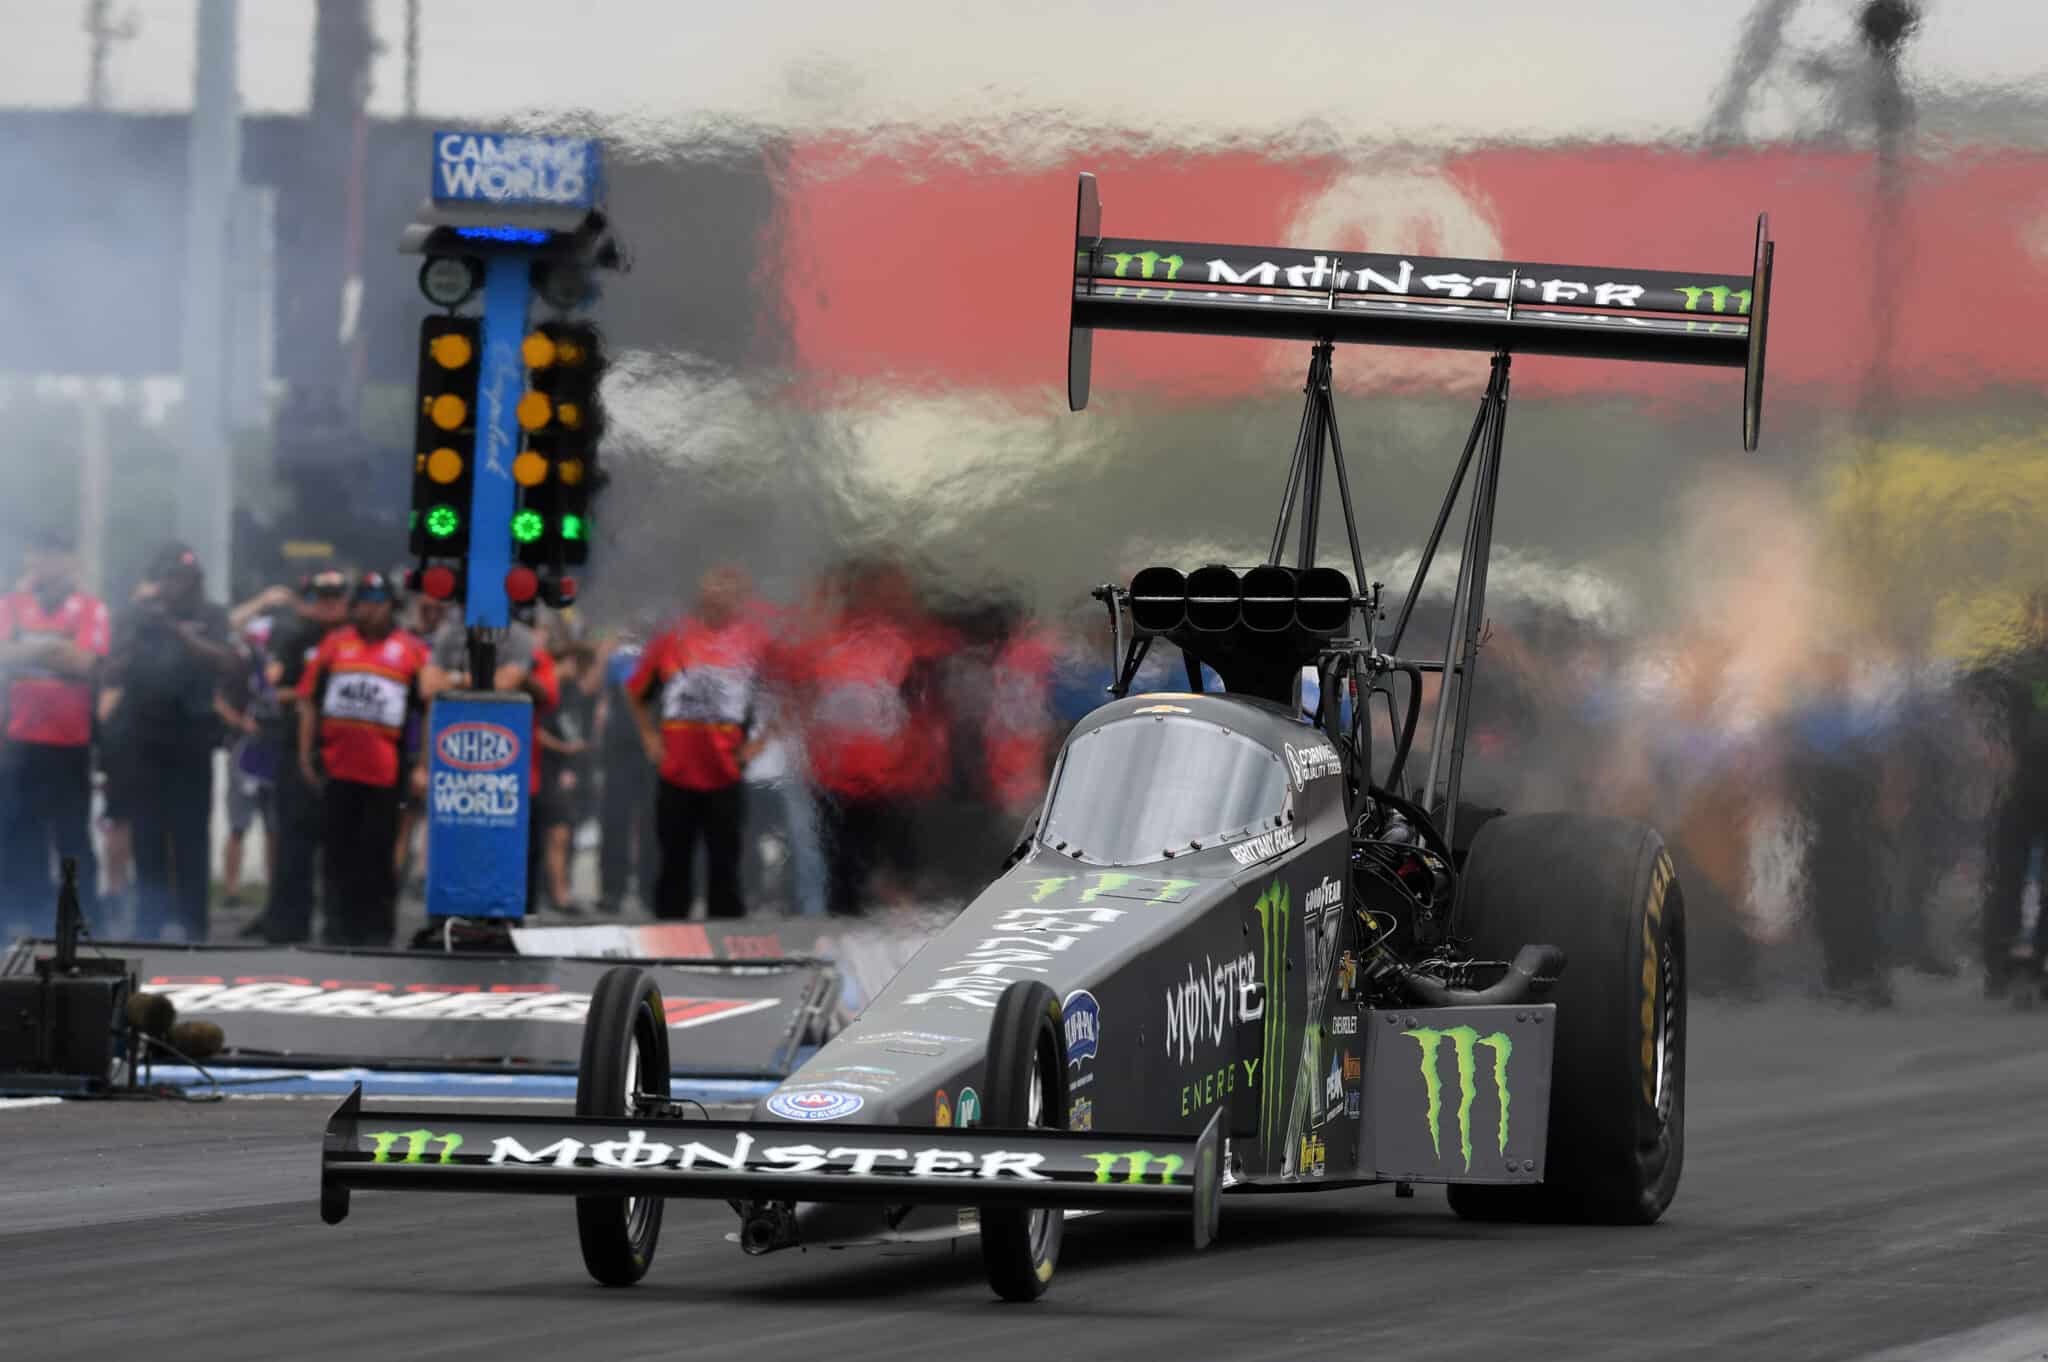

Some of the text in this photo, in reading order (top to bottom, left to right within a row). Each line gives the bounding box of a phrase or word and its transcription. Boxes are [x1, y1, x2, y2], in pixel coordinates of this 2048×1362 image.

[441, 163, 585, 199] WORLD
[1207, 255, 1645, 306] MONSTER
[446, 729, 513, 762] NHRA
[434, 771, 519, 795] CAMPING
[434, 792, 519, 816] WORLD
[1304, 877, 1342, 914] GOODYEAR
[1165, 951, 1265, 1067] MONSTER
[795, 1092, 834, 1104] AAA
[1180, 1058, 1260, 1118] ENERGY
[486, 1130, 1054, 1181] MONSTER
